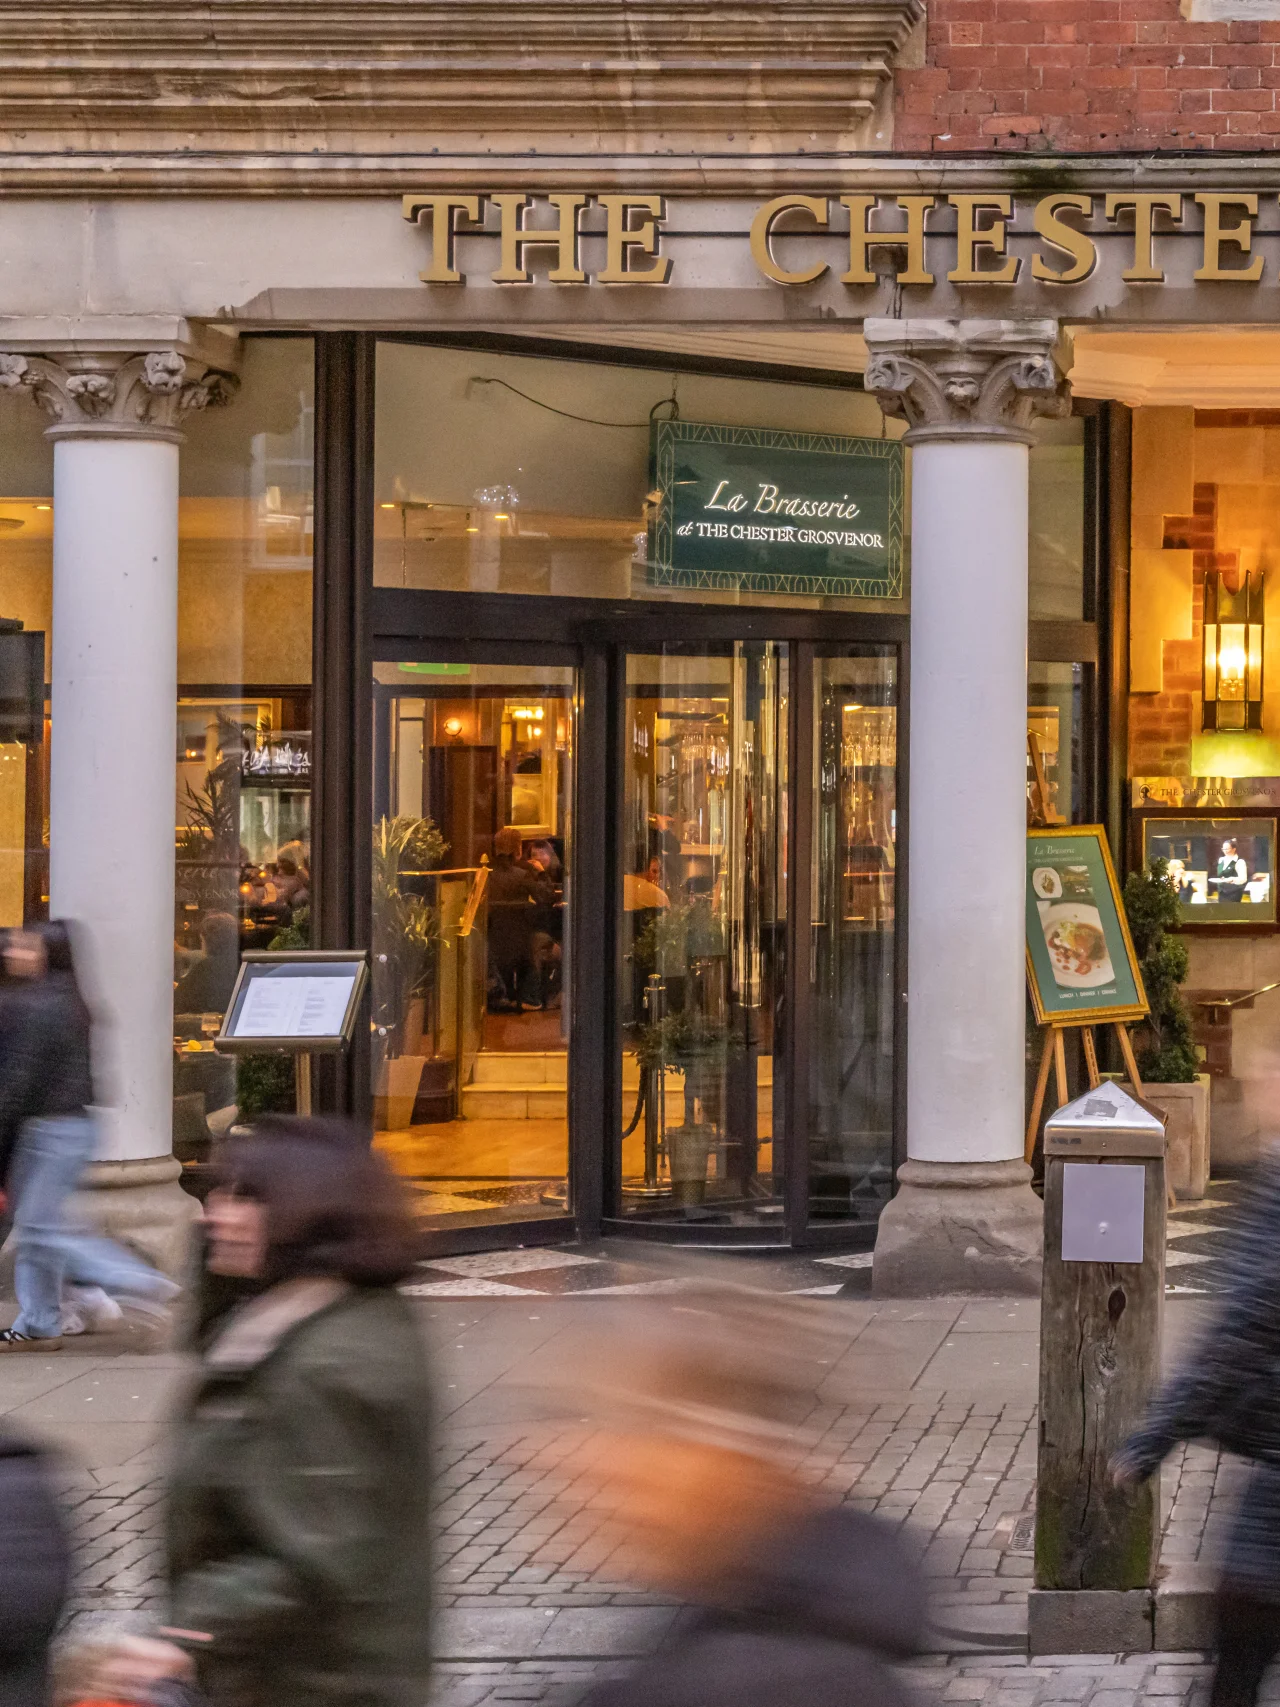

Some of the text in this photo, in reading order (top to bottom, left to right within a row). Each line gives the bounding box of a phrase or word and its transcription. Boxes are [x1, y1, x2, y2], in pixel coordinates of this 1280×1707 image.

[403, 194, 674, 285] THE
[704, 480, 860, 520] La Brasserie
[676, 521, 884, 548] at THE CHESTER GROSVENOR
[1161, 788, 1178, 796] THE
[1183, 788, 1221, 796] CHESTER
